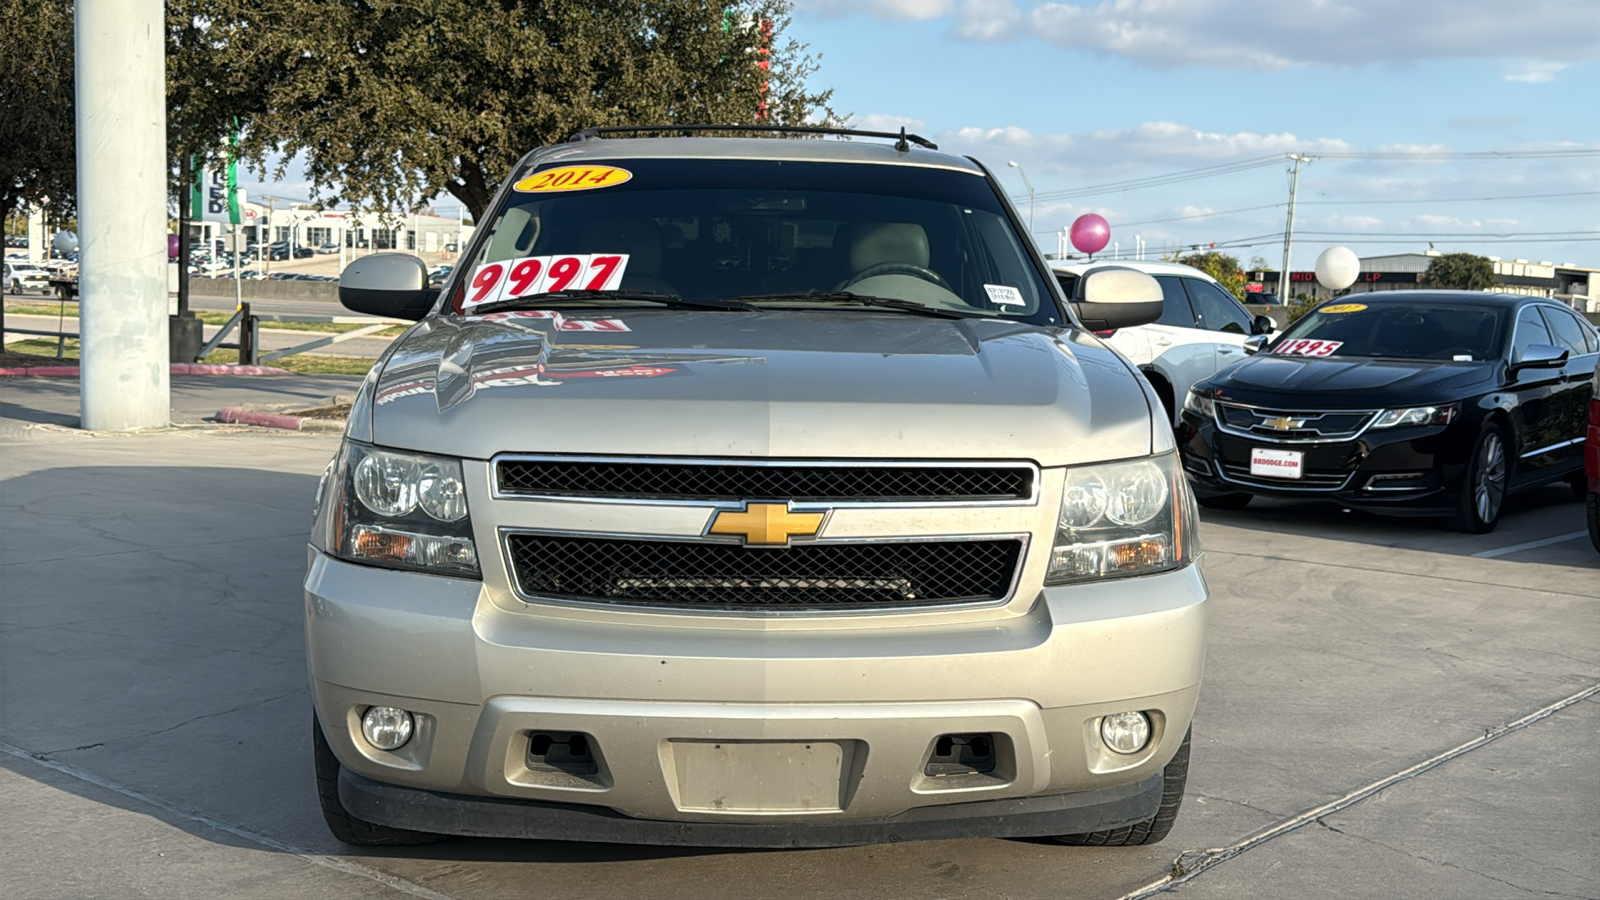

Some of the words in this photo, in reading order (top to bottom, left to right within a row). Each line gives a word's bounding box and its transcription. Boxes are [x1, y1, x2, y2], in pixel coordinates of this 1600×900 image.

[532, 169, 616, 190] 2014
[472, 255, 622, 303] 9997
[1272, 340, 1341, 356] 11995
[1253, 457, 1299, 468] BBDODGE.COM
